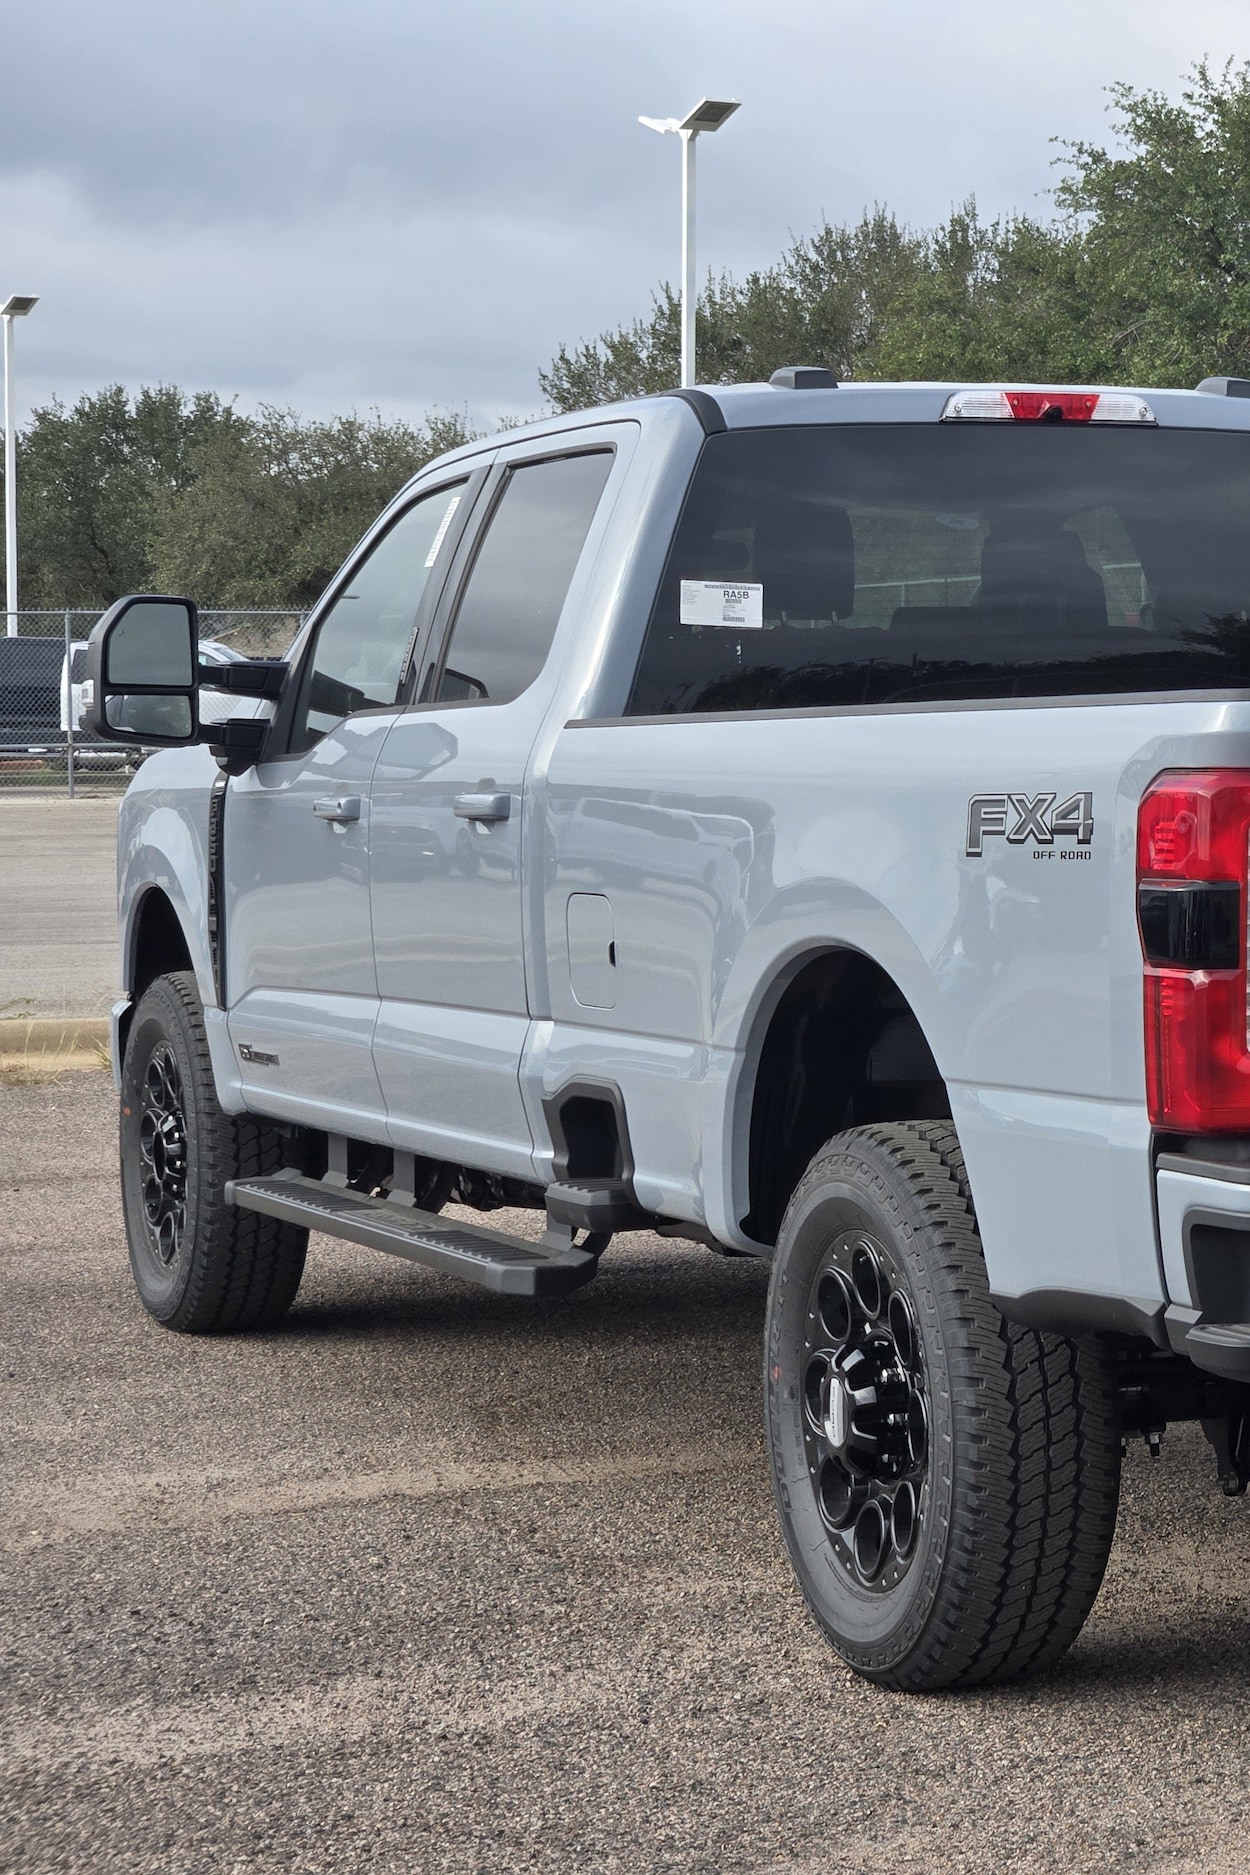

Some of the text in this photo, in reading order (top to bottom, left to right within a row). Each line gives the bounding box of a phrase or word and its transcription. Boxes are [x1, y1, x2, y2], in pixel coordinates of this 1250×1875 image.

[723, 590, 750, 600] RA5B
[965, 790, 1095, 858] FX4
[1033, 850, 1092, 860] OFF ROAD
